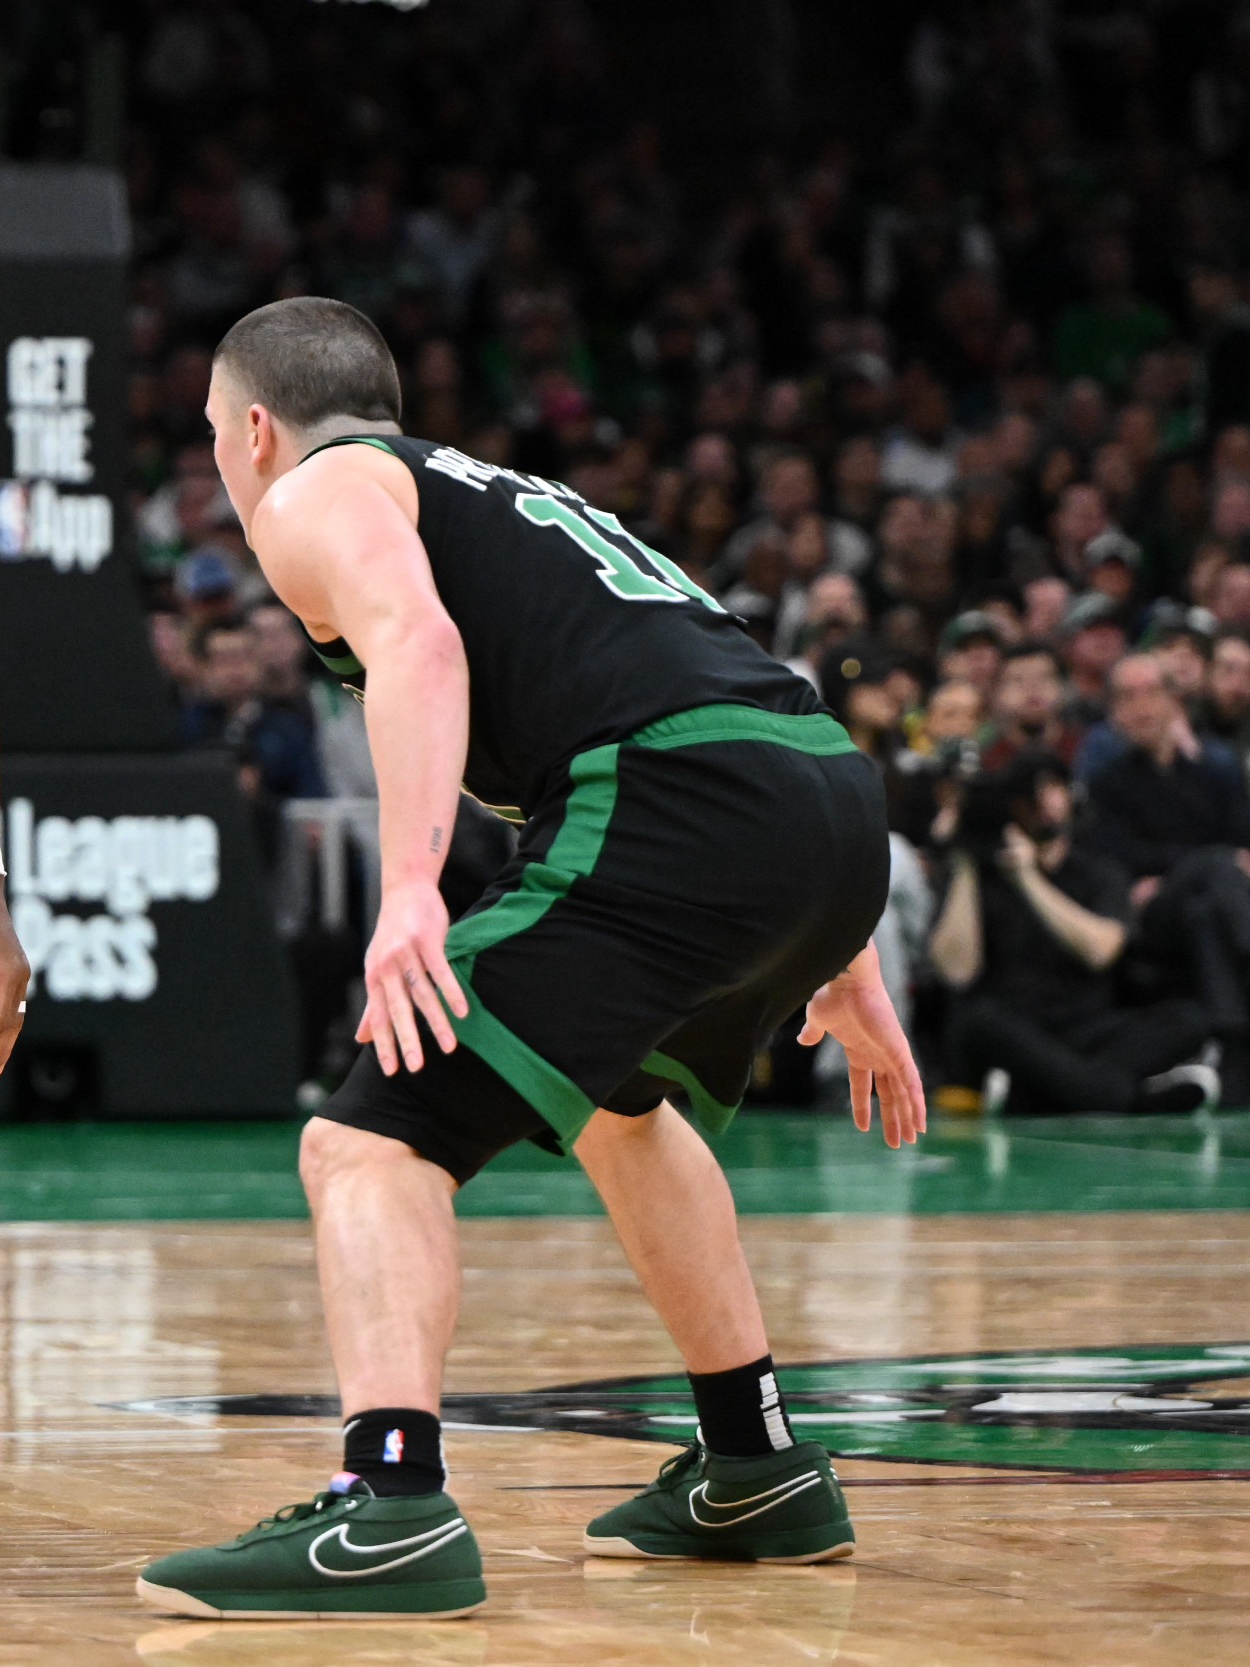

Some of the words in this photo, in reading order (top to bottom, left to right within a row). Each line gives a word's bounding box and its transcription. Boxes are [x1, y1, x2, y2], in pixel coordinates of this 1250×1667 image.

[8, 337, 94, 405] GET
[7, 406, 95, 482] THE
[8, 798, 219, 914] League
[12, 895, 158, 1000] Pass
